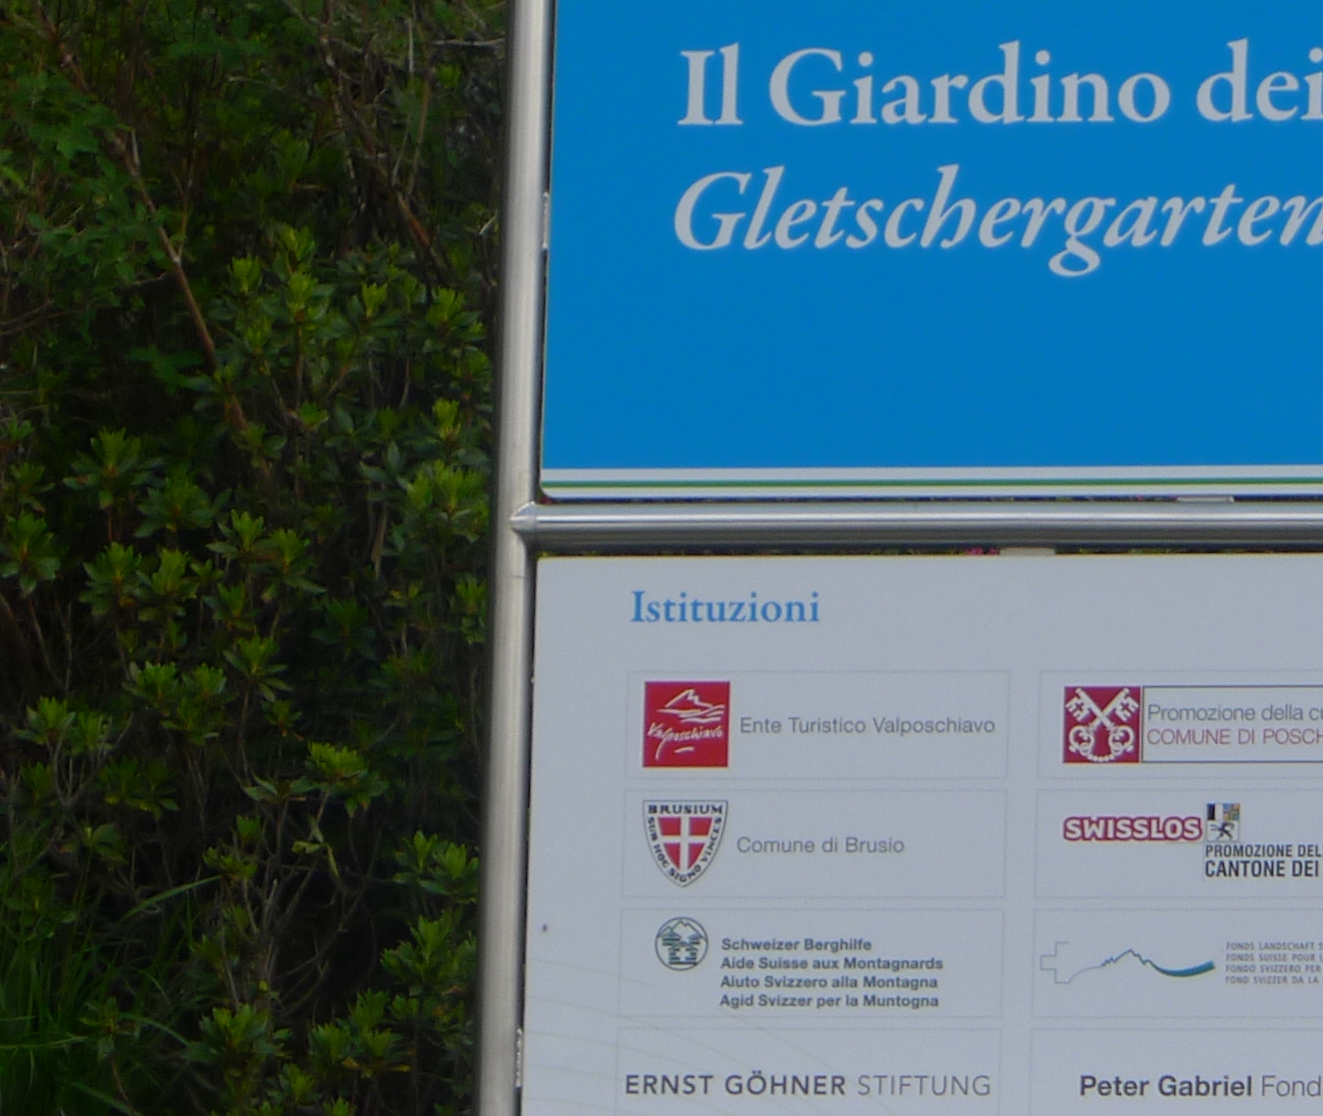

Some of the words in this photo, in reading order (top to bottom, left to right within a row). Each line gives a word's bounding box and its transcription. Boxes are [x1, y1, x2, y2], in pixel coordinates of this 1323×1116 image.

[678, 43, 743, 125] Il
[769, 40, 1171, 126] Giardino
[632, 591, 818, 622] Istituzioni
[1148, 704, 1255, 722] Promozione
[1261, 703, 1303, 721] della
[740, 716, 782, 734] Ente
[788, 714, 866, 734] Turistico
[872, 717, 995, 736] Valposchiavo
[1147, 729, 1231, 745] COMUNE
[1238, 729, 1255, 745] DI
[648, 803, 723, 815] BRUSIUM
[1064, 817, 1202, 842] SWISSLOS
[736, 835, 815, 853] Comune
[821, 837, 838, 853] di
[843, 833, 905, 853] Brusio
[1205, 844, 1292, 858] PROMOZIONE
[1205, 860, 1288, 877] CANTONE
[1293, 860, 1319, 877] DEI
[721, 938, 800, 952] Schweizer
[804, 938, 872, 954] Berghilfe
[720, 955, 754, 969] Aide
[759, 954, 808, 969] Suisse
[813, 956, 839, 969] aux
[844, 954, 944, 972] Montagnards
[719, 975, 760, 988] Aiuto
[765, 973, 828, 988] Svizzero
[831, 975, 858, 988] alla
[863, 975, 939, 991] Montagna
[720, 994, 754, 1009] Agid
[759, 994, 812, 1007] Svizzer
[817, 995, 841, 1009] per
[846, 995, 858, 1007] la
[863, 993, 939, 1010] Muntogna
[626, 1074, 714, 1095] ERNST
[725, 1070, 845, 1095] GÖHNER
[858, 1075, 990, 1096] STIFTUNG
[1080, 1075, 1150, 1097] Peter
[1158, 1075, 1252, 1097] Gabriel
[1262, 1075, 1321, 1097] Fond
